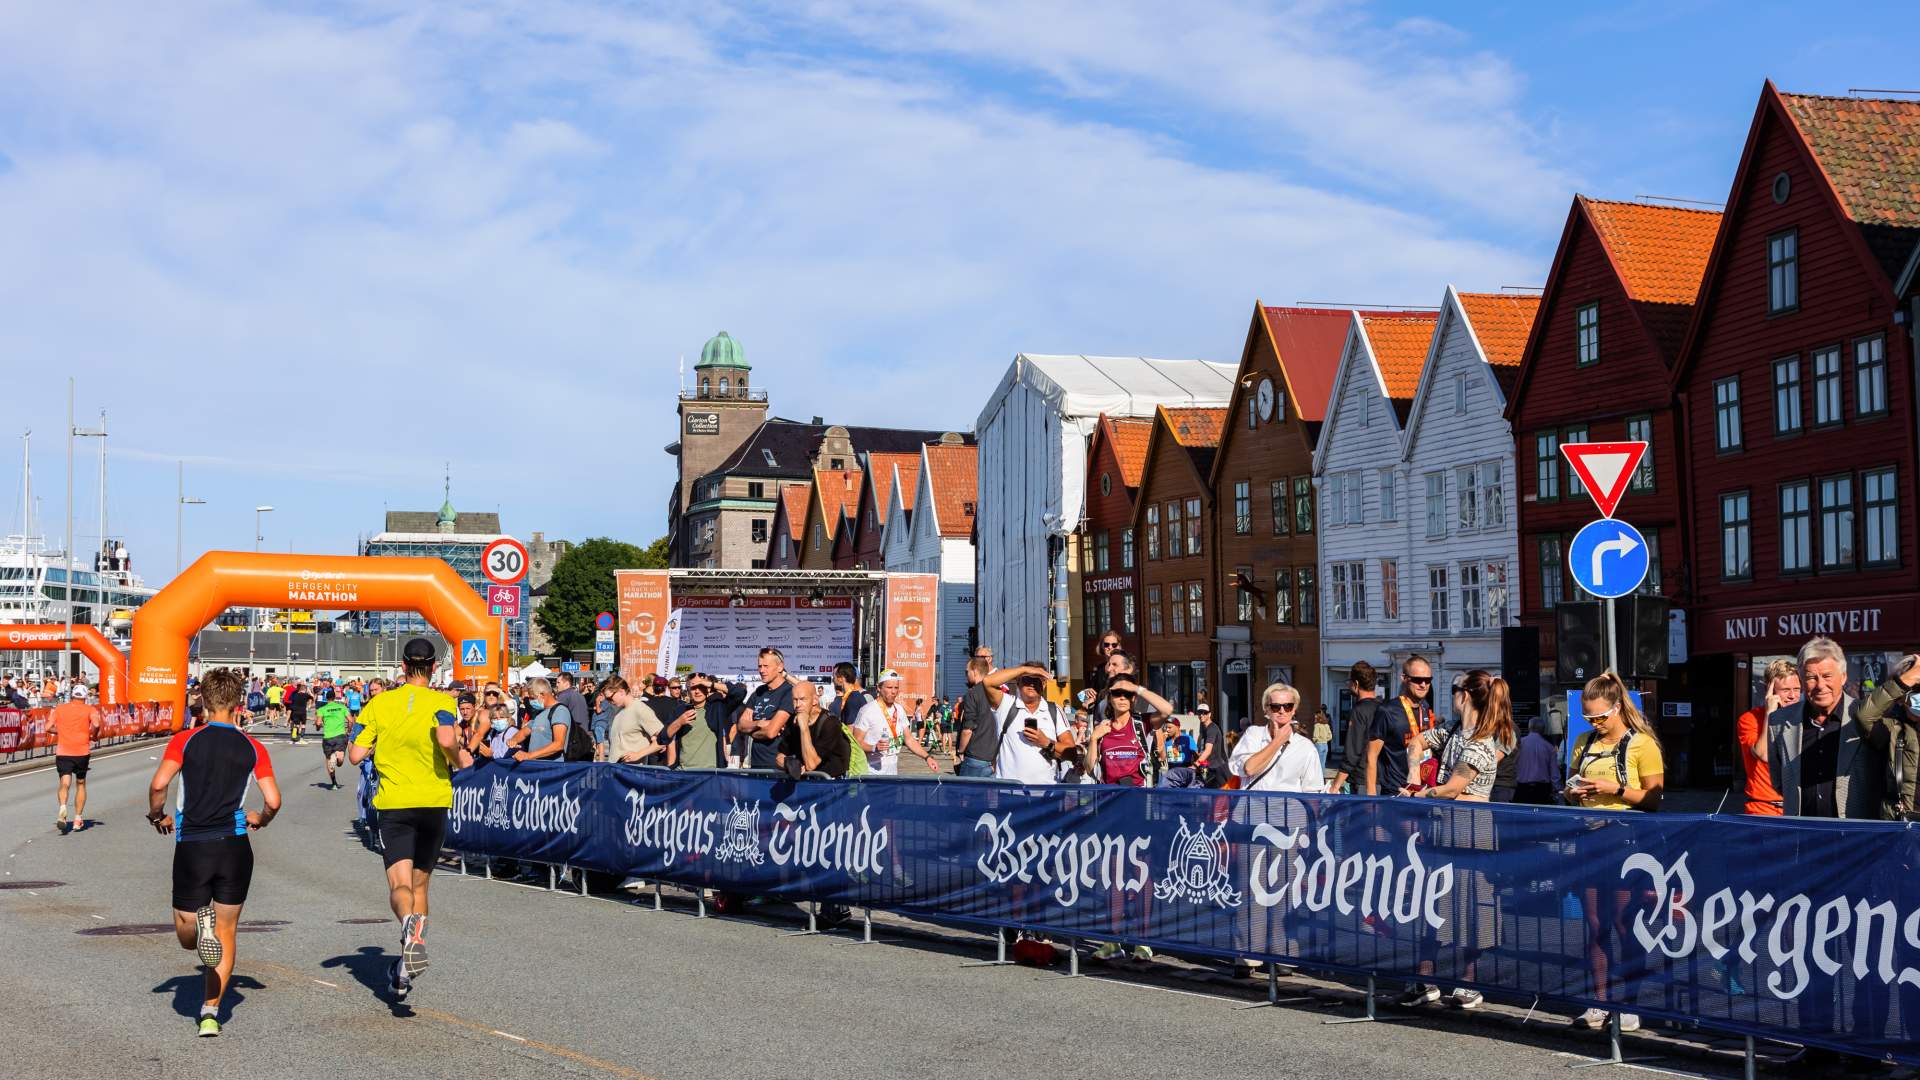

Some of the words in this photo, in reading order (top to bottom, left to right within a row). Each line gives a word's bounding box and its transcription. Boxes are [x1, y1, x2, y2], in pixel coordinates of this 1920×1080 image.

[491, 550, 521, 573] 30
[288, 582, 331, 591] BERGEN
[335, 583, 358, 592] CITY
[1093, 576, 1133, 592] STORHEIM
[288, 591, 358, 601] MARATHON
[623, 591, 663, 599] MARATHON
[749, 599, 786, 607] Fjordkraft
[1725, 616, 1769, 640] KNUT
[1777, 609, 1882, 636] SKURTVEIT
[512, 777, 581, 834] Tidende
[624, 787, 718, 867] Bergens
[768, 802, 888, 875] Tidende
[974, 811, 1152, 907] Bergens
[1249, 822, 1454, 930] Tidende
